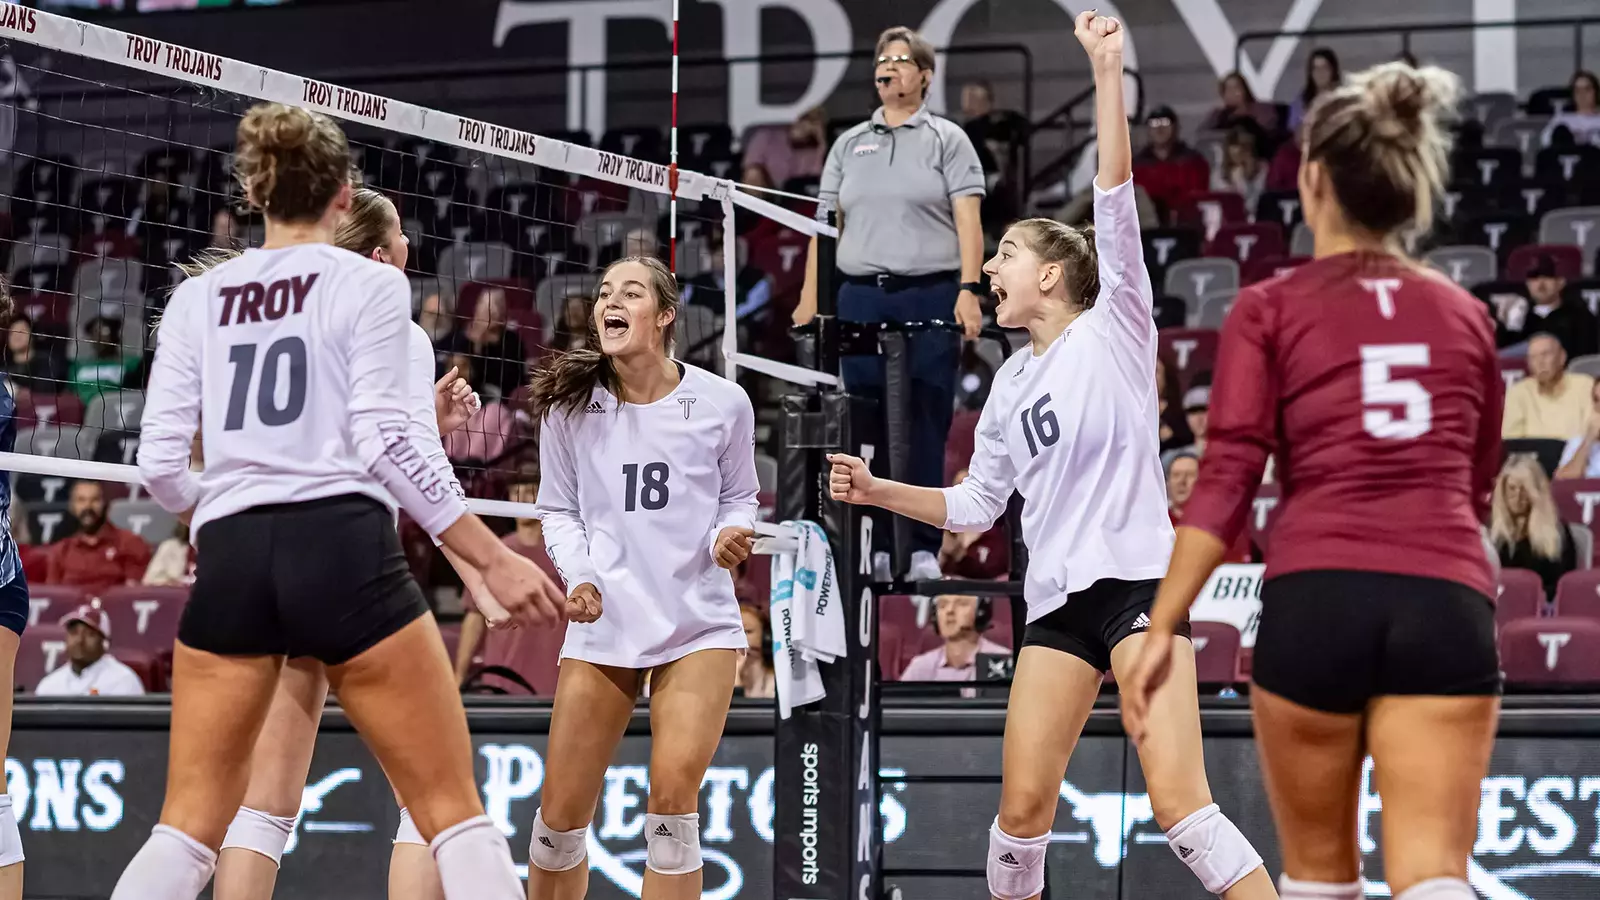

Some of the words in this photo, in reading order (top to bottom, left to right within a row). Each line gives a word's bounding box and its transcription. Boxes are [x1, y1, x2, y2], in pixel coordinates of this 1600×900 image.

[126, 34, 162, 65] TROY
[165, 44, 223, 81] TROJANS
[302, 79, 334, 108] TROY
[337, 87, 388, 121] TROJANS
[458, 117, 487, 145] TROY
[490, 126, 537, 157] TROJANS
[597, 151, 624, 178] TROY
[624, 158, 666, 187] TROJANS
[218, 272, 319, 327] TROY
[223, 336, 308, 431] 10
[1359, 344, 1433, 440] 5
[1020, 392, 1061, 459] 16
[621, 460, 670, 512] 18
[799, 742, 821, 806] sports
[799, 808, 820, 885] imports
